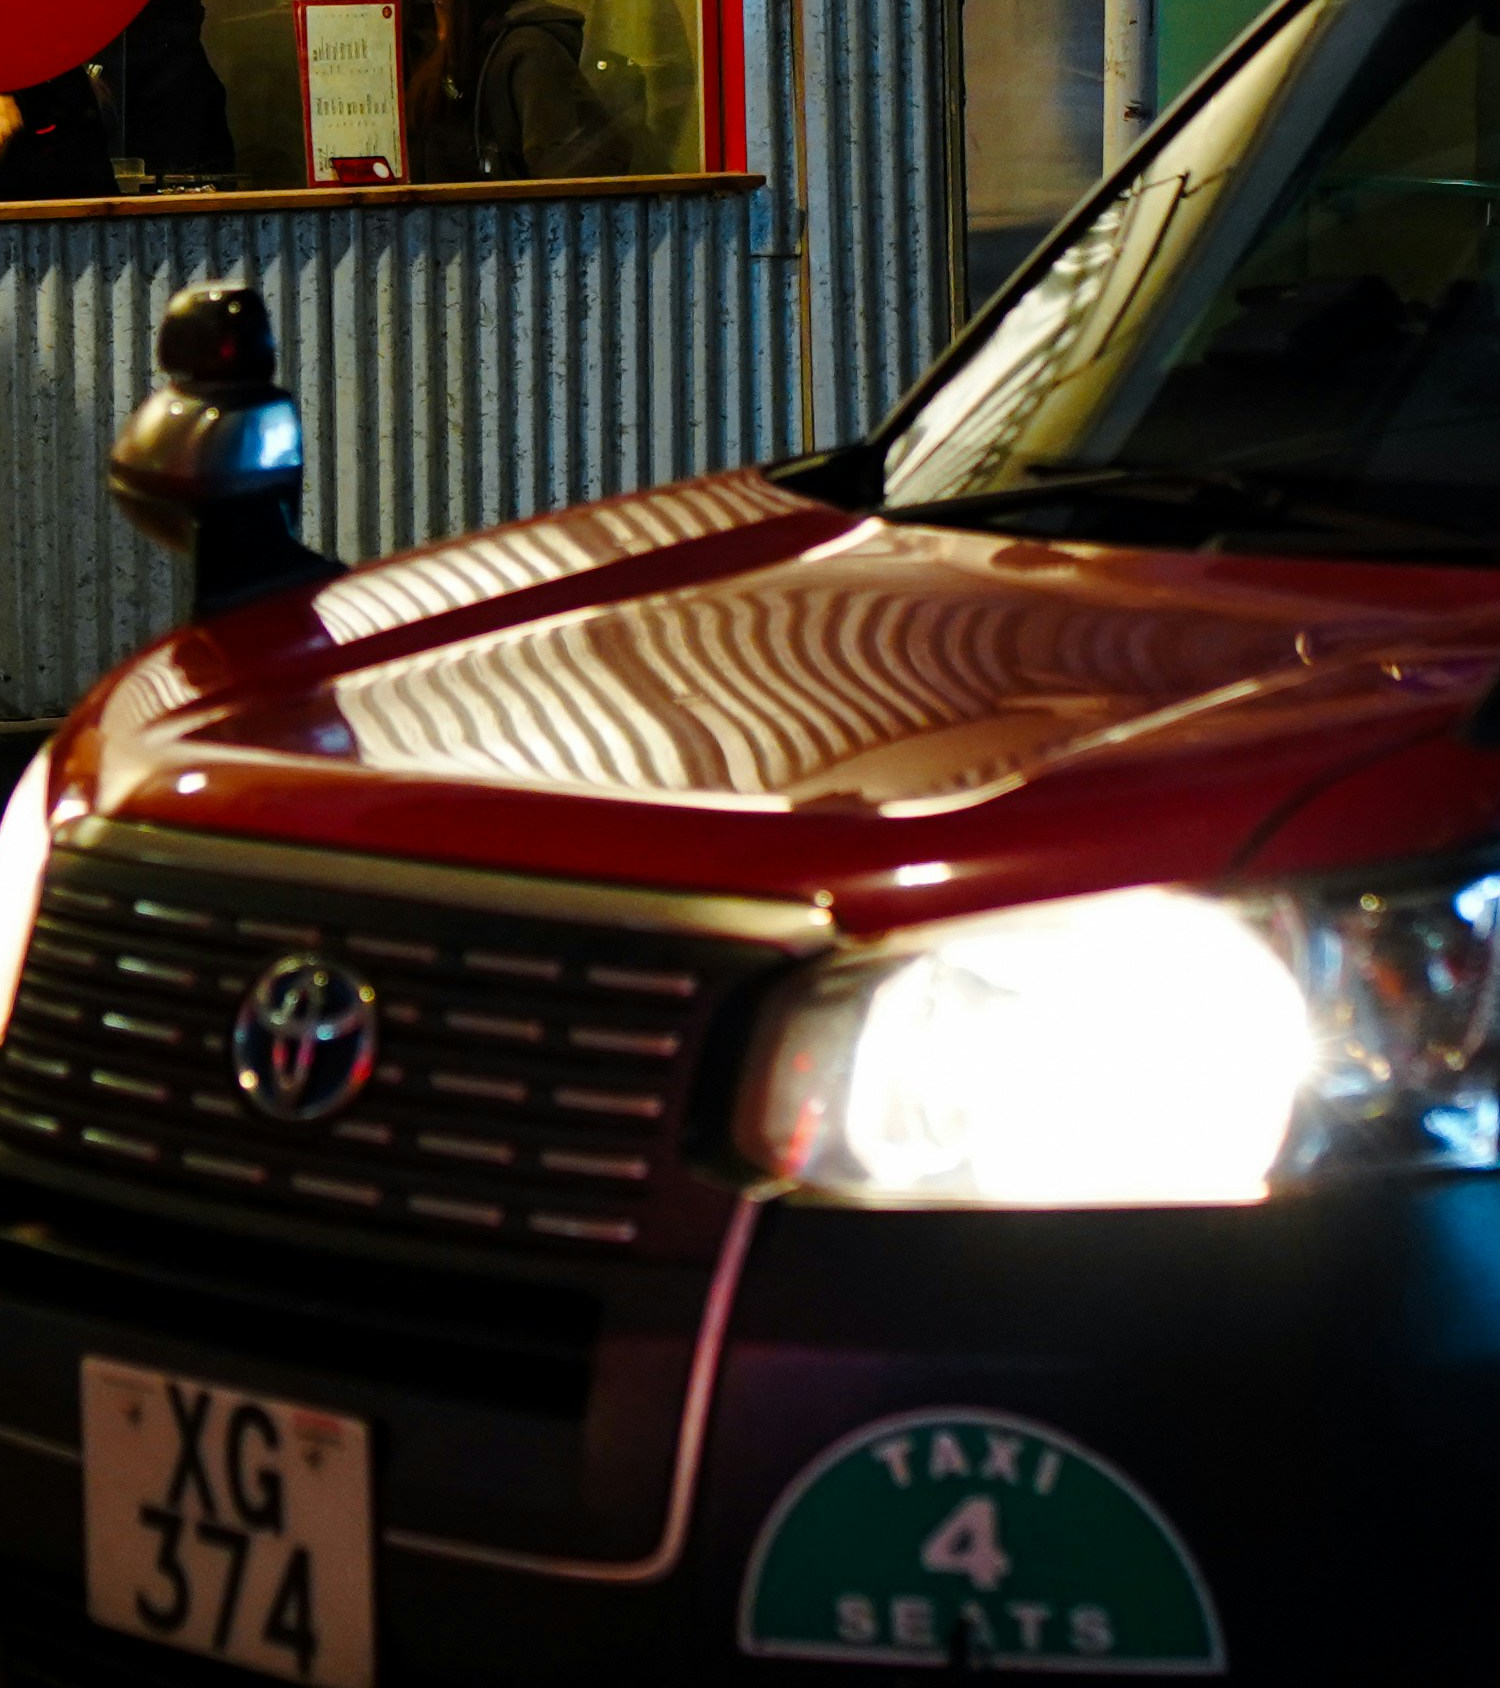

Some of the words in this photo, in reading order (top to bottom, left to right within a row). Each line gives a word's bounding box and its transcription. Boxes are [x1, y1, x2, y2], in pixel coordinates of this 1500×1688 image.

[164, 1381, 284, 1536] XG
[869, 1428, 1064, 1498] TAXI
[136, 1502, 318, 1676] 374
[917, 1491, 1013, 1594] 4
[833, 1590, 1117, 1658] SEATS
